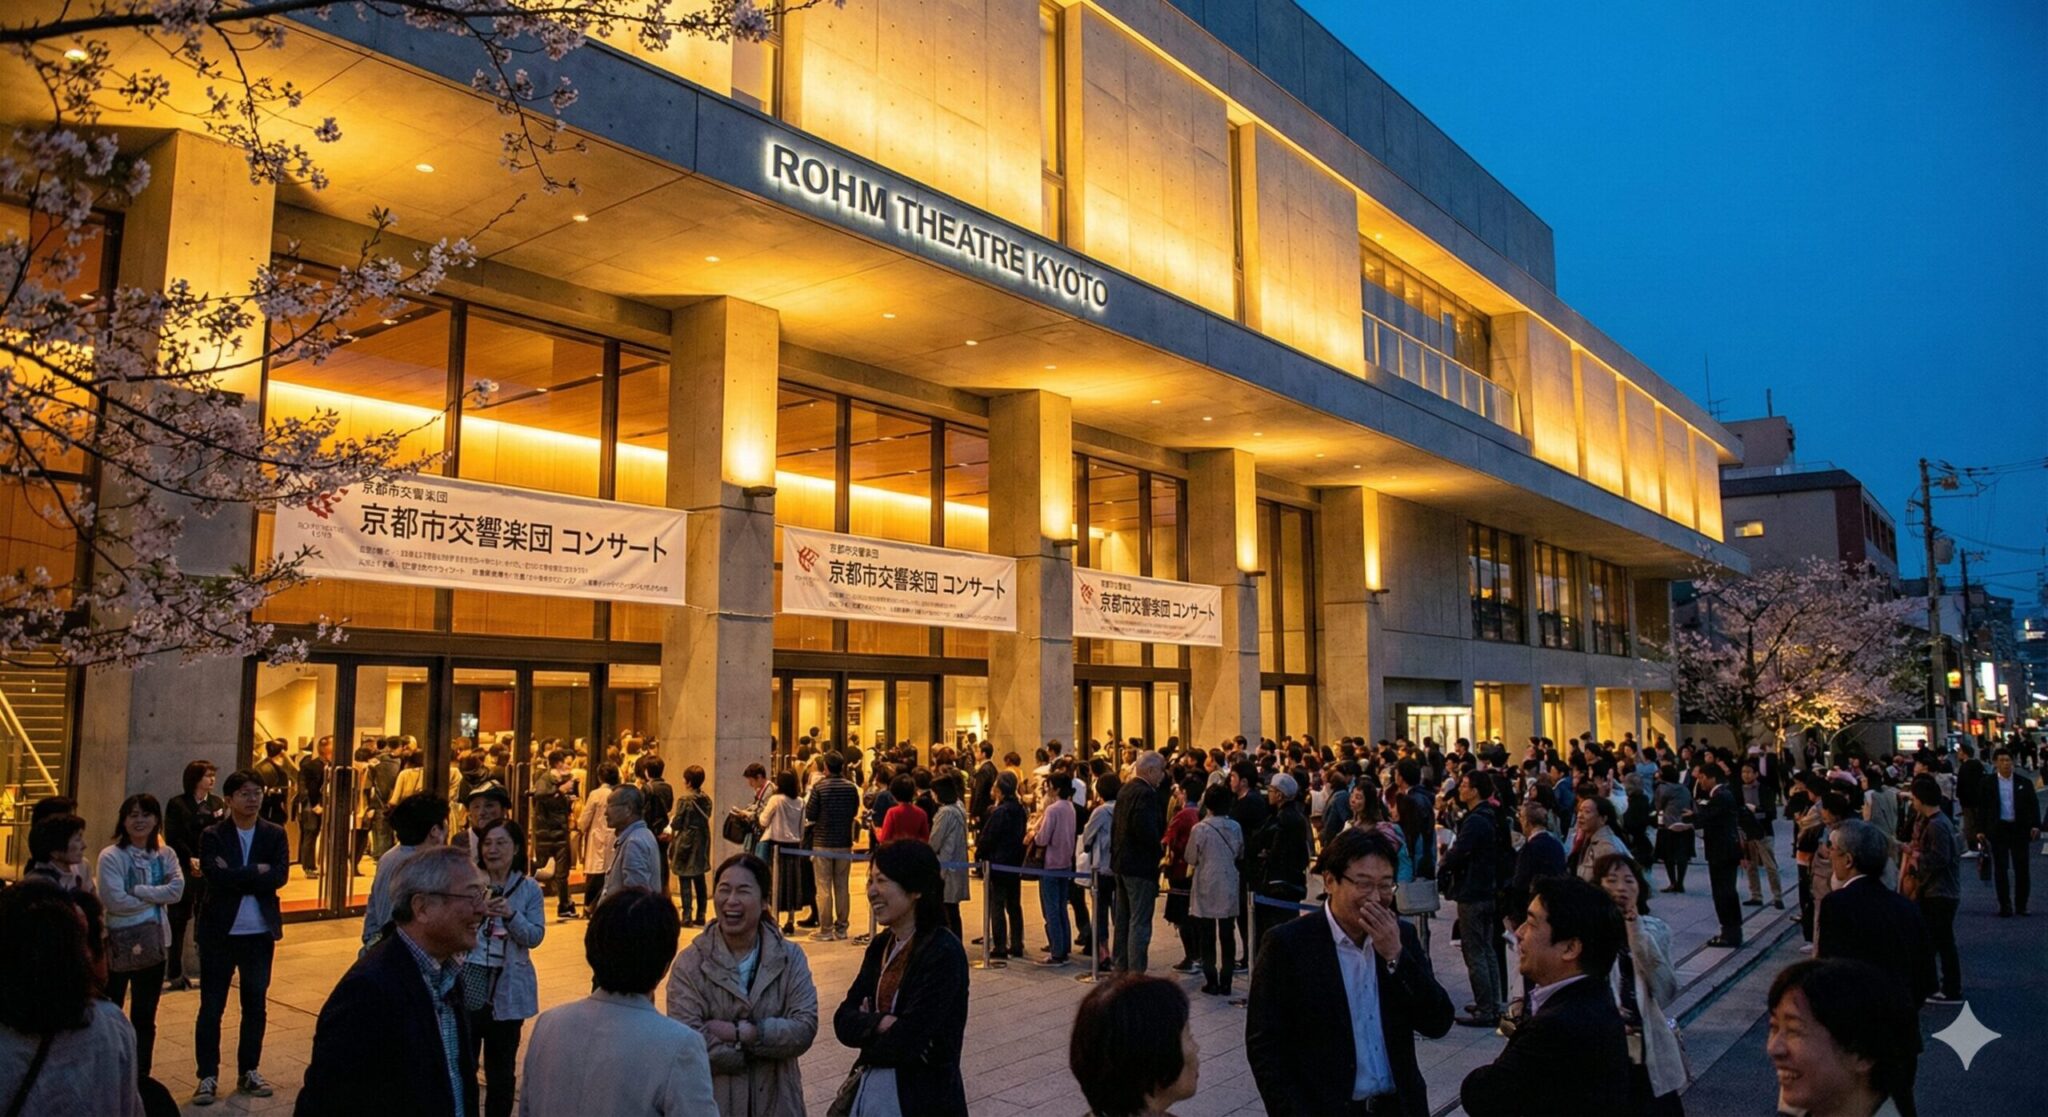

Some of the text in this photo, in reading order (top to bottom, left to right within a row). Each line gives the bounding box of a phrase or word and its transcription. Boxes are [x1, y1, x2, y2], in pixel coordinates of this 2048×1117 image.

[773, 144, 1108, 307] ROHM THEATRE KYOTO
[360, 502, 553, 555] 京都市交響楽団
[562, 528, 668, 563] コンサート
[829, 559, 938, 595] 京都市交響楽団
[943, 575, 1005, 600] コンサート
[1173, 602, 1215, 621] コンサート
